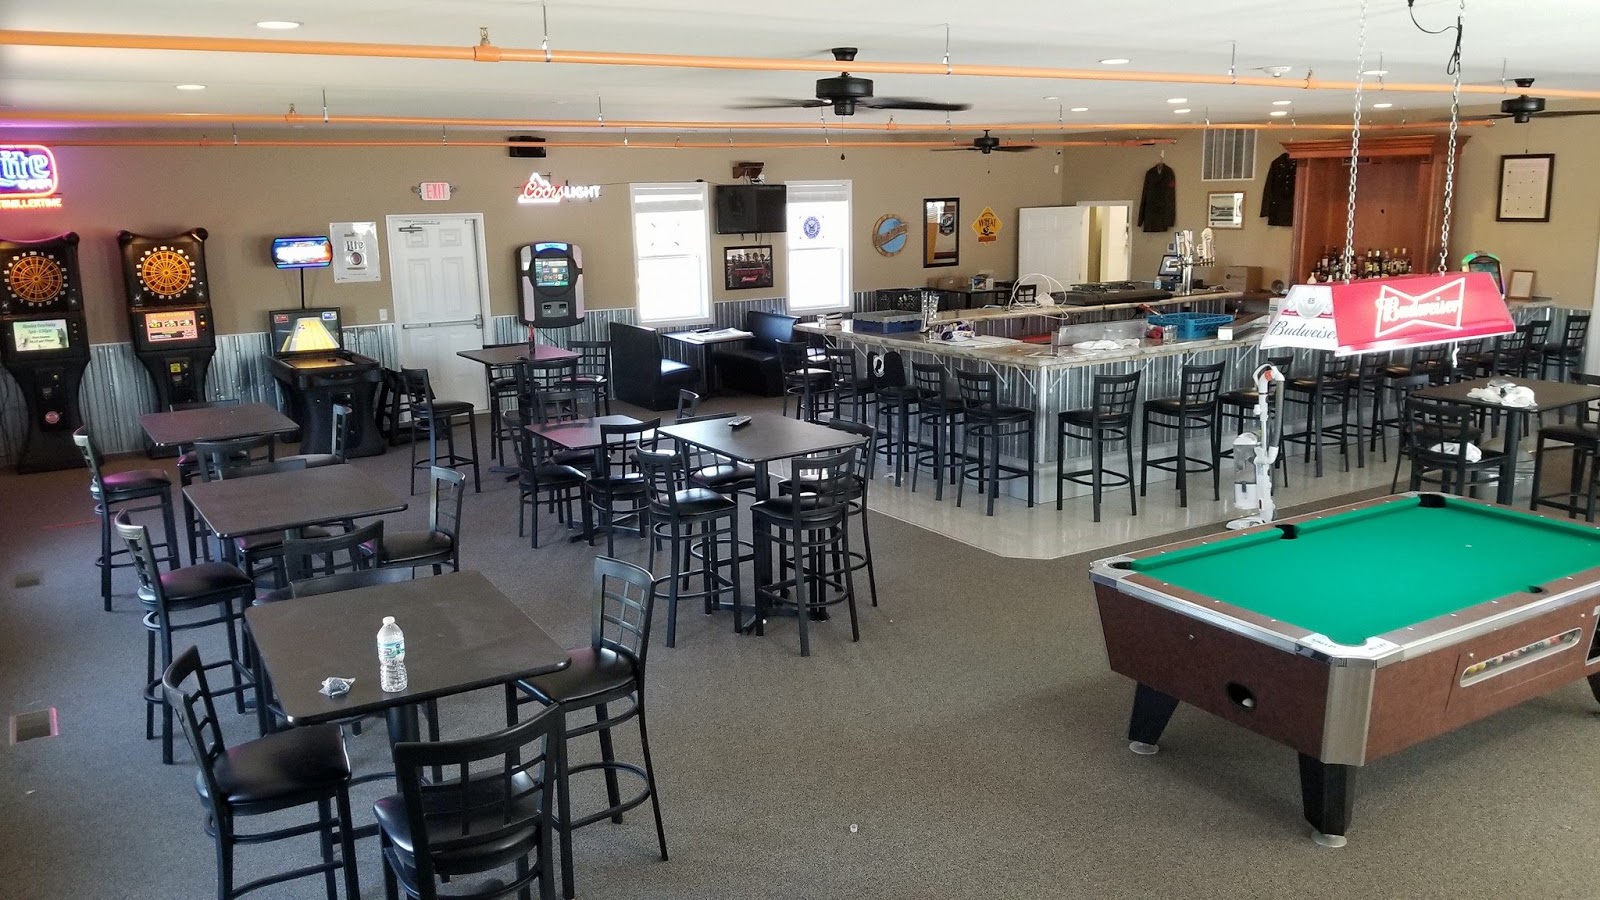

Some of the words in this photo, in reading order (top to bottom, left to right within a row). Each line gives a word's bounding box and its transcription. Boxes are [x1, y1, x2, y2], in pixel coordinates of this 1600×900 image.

[0, 150, 51, 179] ite
[426, 183, 446, 199] EXIT
[523, 181, 565, 199] Coors
[565, 185, 601, 199] LIGHT
[1374, 295, 1462, 323] Budweiser
[1269, 320, 1336, 340] Budweise
